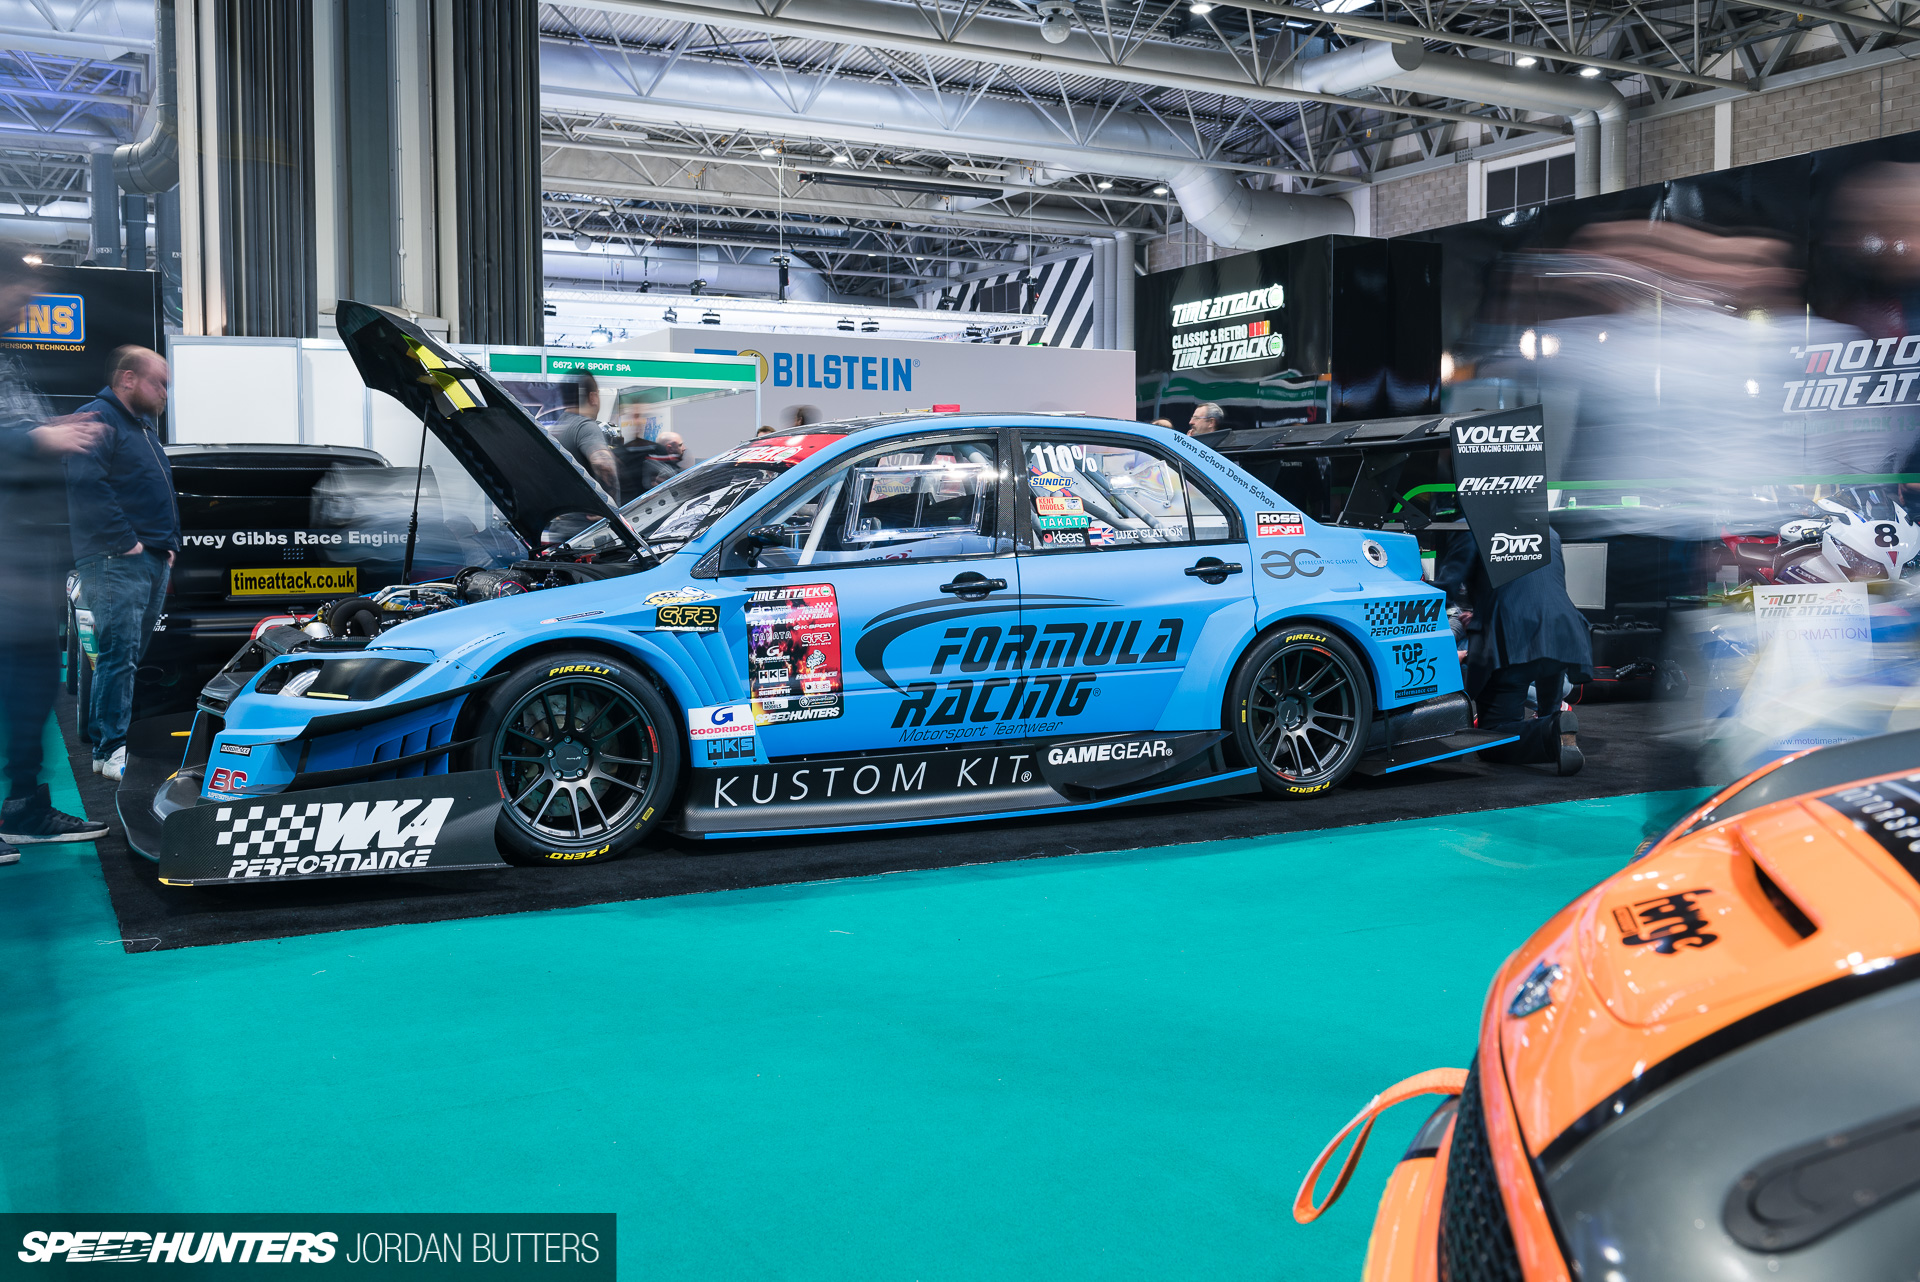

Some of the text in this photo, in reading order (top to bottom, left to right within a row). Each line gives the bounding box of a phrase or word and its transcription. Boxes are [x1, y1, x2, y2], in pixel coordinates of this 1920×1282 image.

[1172, 324, 1248, 349] CLASSIC & RETRO
[35, 343, 85, 351] TECHNOLOGY
[553, 361, 631, 372] 6672 V2 SPORT SPA
[774, 353, 912, 392] BILSTEIN
[1866, 372, 1920, 404] AT
[1456, 425, 1543, 443] VOLTEX
[1031, 444, 1098, 473] 110%
[1458, 445, 1479, 453] VOLTEX
[1480, 445, 1501, 453] RACING
[1173, 433, 1275, 509] Wenn Schon Denn Schon
[1032, 477, 1071, 487] SUNOCO
[1041, 517, 1088, 527] TAKATA
[1258, 514, 1300, 524] ROSS
[1115, 527, 1184, 540] LUKE CLAYTON
[1260, 525, 1302, 535] SPORT
[1874, 523, 1900, 547] 8
[182, 533, 226, 549] rvey
[232, 531, 288, 546] Gibbs
[294, 531, 342, 545] Race
[1490, 532, 1543, 555] DWR
[1490, 554, 1543, 562] Performance
[233, 570, 355, 590] timeattack.co.uk
[748, 590, 778, 603] IME
[658, 606, 718, 626] GFB
[1398, 599, 1444, 624] WKA
[1285, 633, 1327, 643] PIRELLI
[1370, 623, 1437, 637] PERFORMANCE
[1761, 627, 1868, 641] INORMATION
[930, 618, 1184, 674] FORMULA
[1392, 643, 1423, 665] TOP
[549, 665, 610, 677] PIRELLI
[759, 669, 788, 680] HKS
[1401, 657, 1438, 688] 555
[890, 673, 1097, 729] RACING
[755, 707, 840, 723] SPEEDHUNTERS
[690, 725, 754, 735] GOODRIDGE
[898, 721, 1063, 743] Motorsport Teamwear
[707, 737, 755, 755] HKS
[1047, 741, 1167, 766] GAMEGEAR
[208, 767, 247, 792] BC
[714, 755, 1029, 808] KUSTOM KIT
[315, 797, 454, 853] WKA
[228, 849, 432, 879] PERFORMANCE
